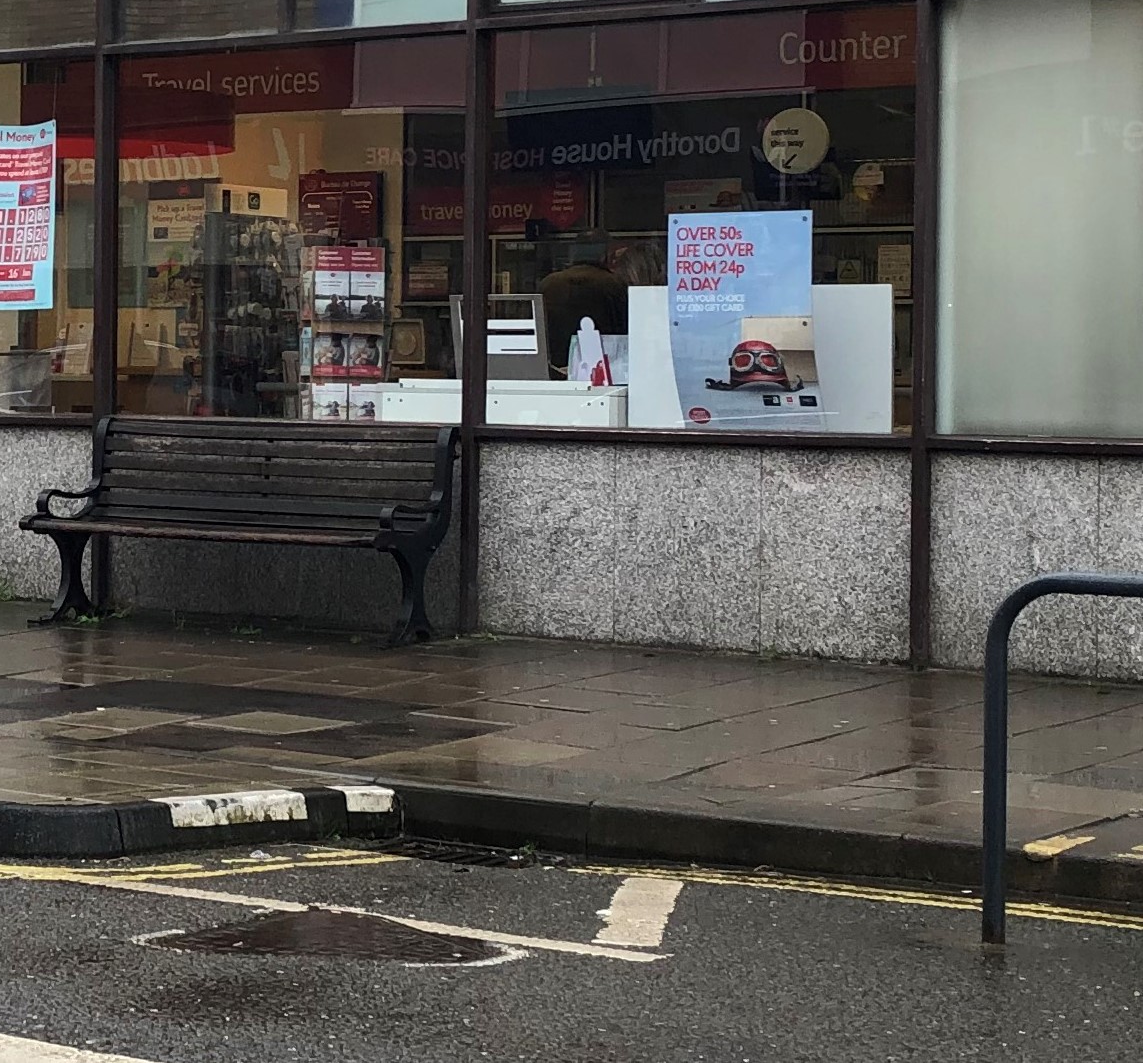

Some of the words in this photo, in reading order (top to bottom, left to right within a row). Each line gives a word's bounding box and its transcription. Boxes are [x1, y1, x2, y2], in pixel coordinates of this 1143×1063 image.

[779, 30, 907, 65] Counter
[221, 65, 321, 97] services
[6, 131, 36, 144] Money
[420, 202, 464, 220] trave
[489, 203, 534, 221] oney
[676, 226, 717, 241] OVER
[719, 226, 743, 241] 50s
[676, 244, 700, 258] LIFE
[703, 242, 755, 258] COVER
[676, 260, 717, 275] FROM
[719, 260, 745, 278] 24p
[676, 278, 689, 292] A
[691, 277, 722, 292] DAY
[676, 294, 694, 303] PLUS
[694, 294, 716, 303] YOUR
[717, 294, 745, 303] CHOICE
[721, 303, 744, 312] CARD
